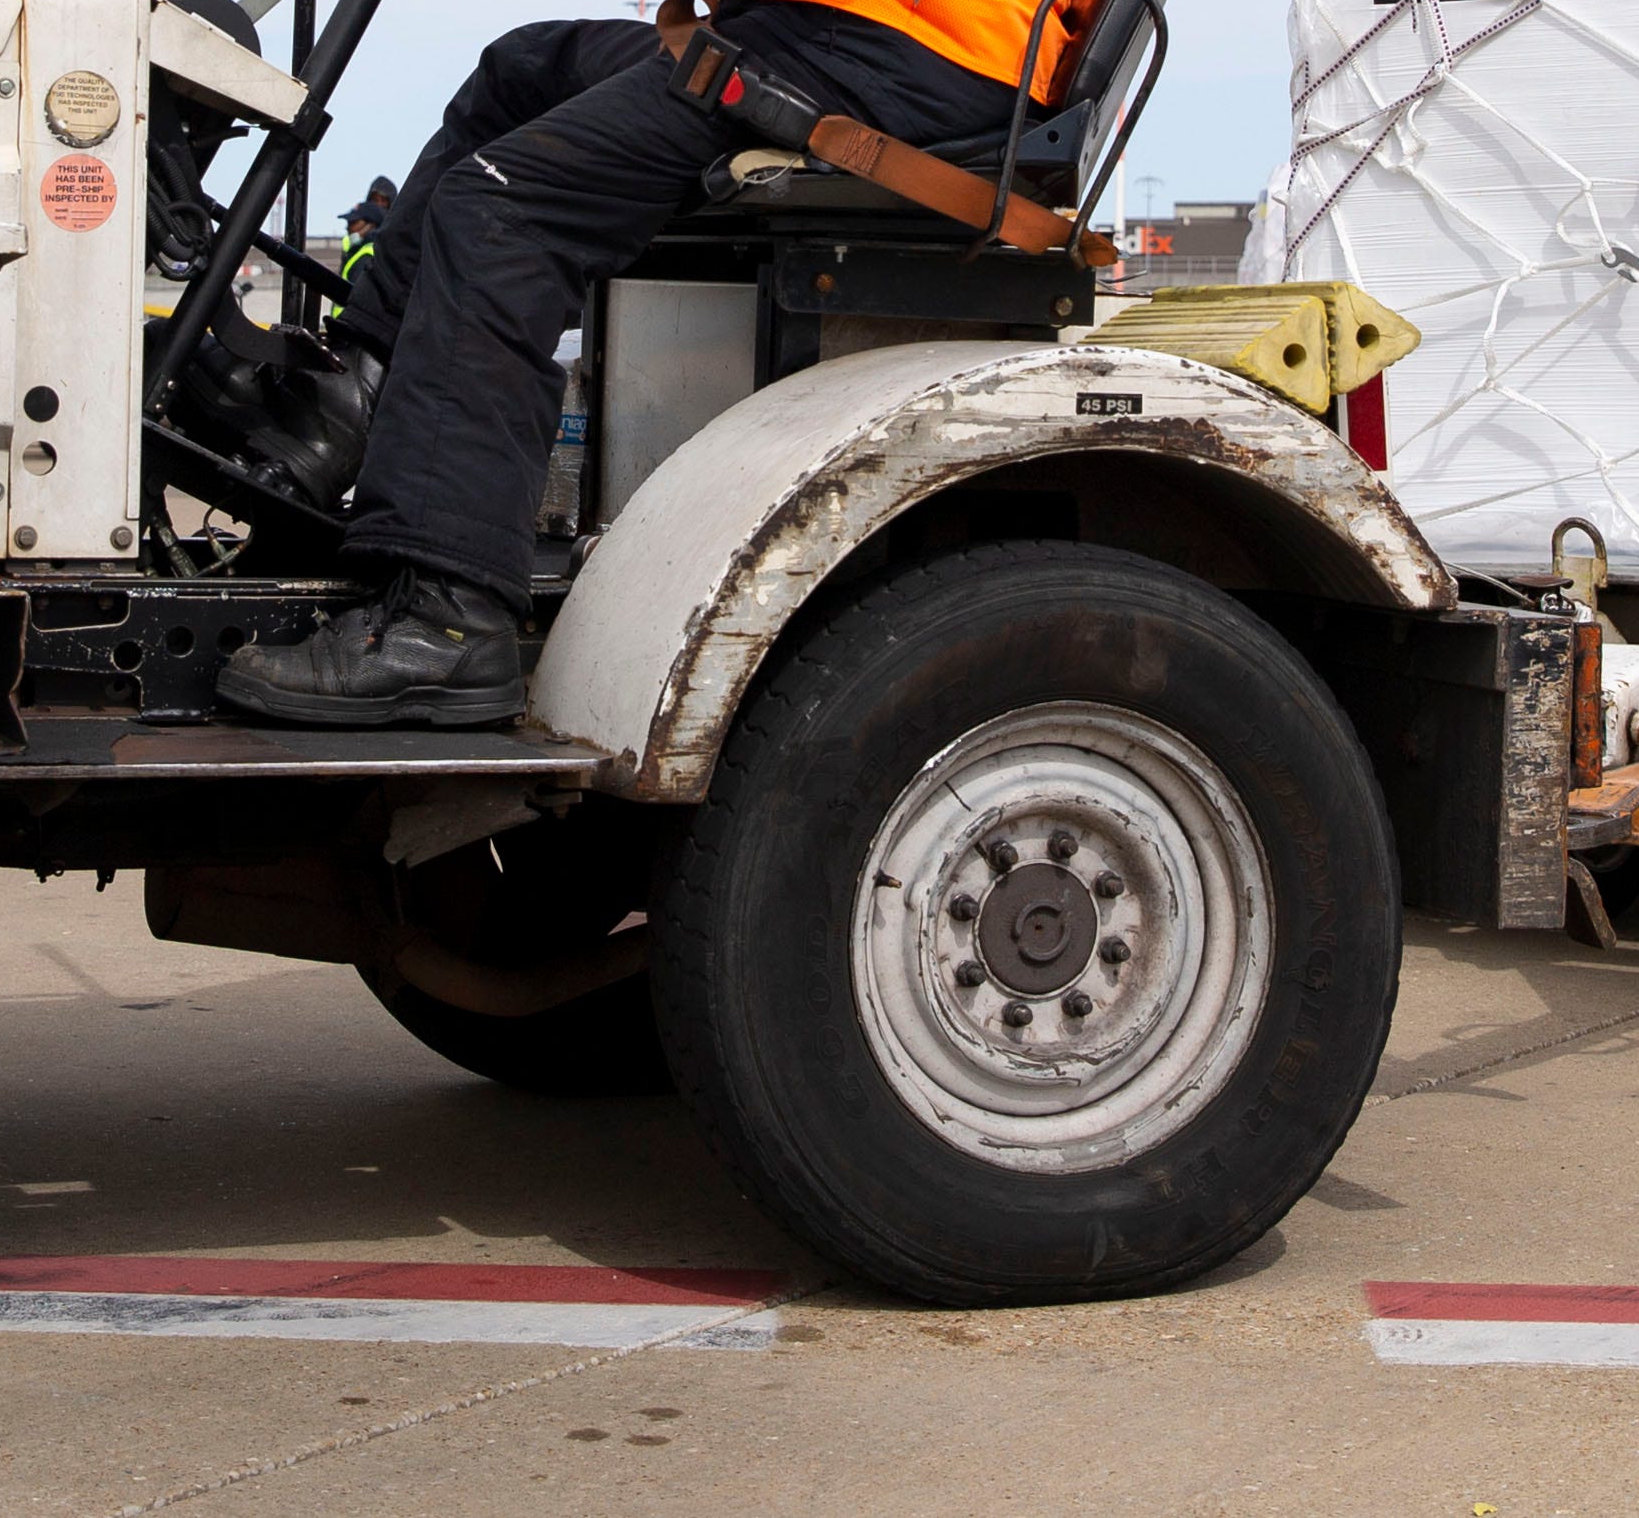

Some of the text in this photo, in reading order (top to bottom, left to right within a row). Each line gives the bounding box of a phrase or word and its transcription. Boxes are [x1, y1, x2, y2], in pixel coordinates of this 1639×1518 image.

[78, 77, 105, 85] QUALITY
[57, 84, 99, 92] DEPARTMENT
[67, 92, 115, 101] TECHNOLOGIES
[73, 100, 108, 108] INSPECTED
[57, 165, 103, 174] THIS UNIT
[55, 175, 104, 183] HAS BEEN
[56, 185, 104, 193] PRE-SHIP
[45, 194, 115, 203] INSPECTED BY
[1113, 225, 1175, 256] dEx
[1081, 399, 1132, 412] 45 PSI
[1233, 720, 1339, 1139] WRANGLER
